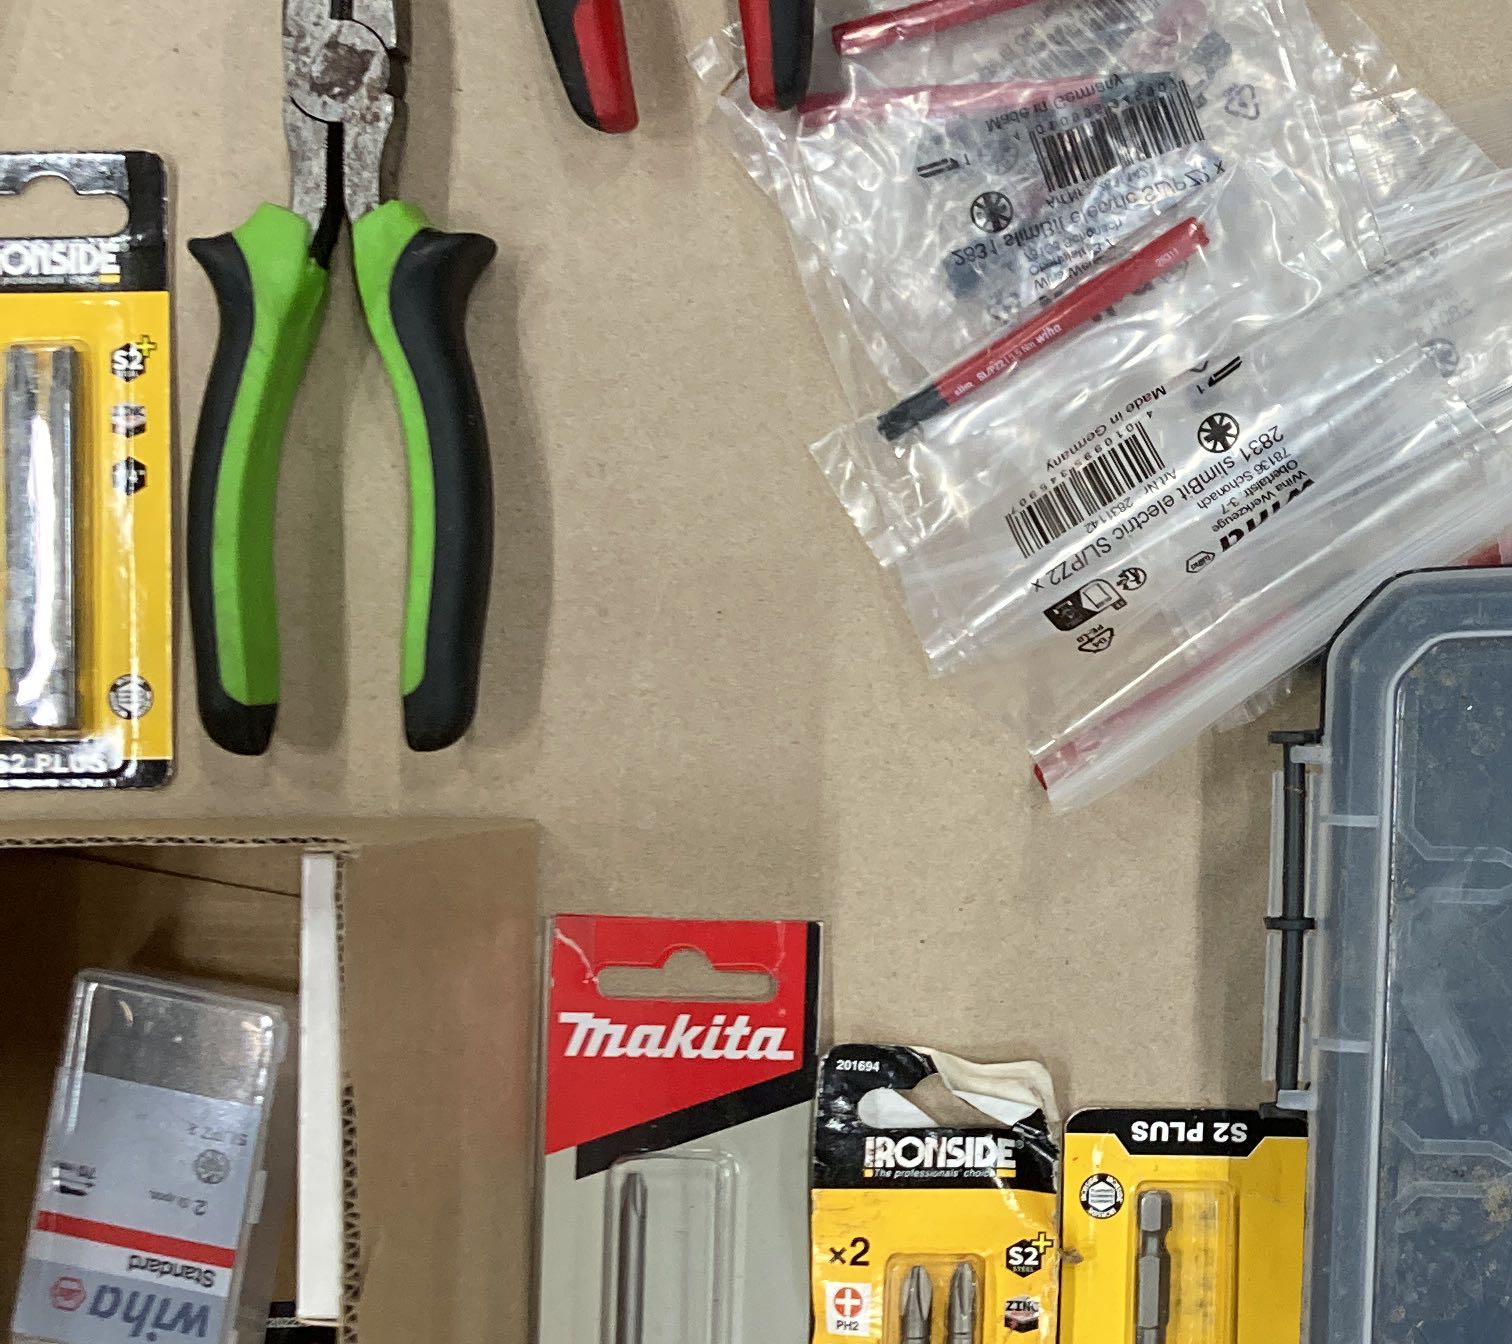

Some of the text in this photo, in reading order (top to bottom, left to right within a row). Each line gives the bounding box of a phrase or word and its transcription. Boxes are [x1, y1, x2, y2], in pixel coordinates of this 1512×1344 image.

[0, 241, 121, 275] ONSIDE
[1041, 382, 1167, 472] Made in Germany
[1195, 446, 1289, 511] 78136 Schonach
[1030, 424, 1285, 592] 2831 slimBit electric SL/PZ2 x
[1082, 496, 1134, 534] 2831142
[1209, 467, 1307, 534] Wiha Werkzeuge
[1218, 495, 1240, 514] 3-7
[558, 1012, 794, 1060] Makita
[836, 1059, 880, 1072] 201694
[1130, 1121, 1248, 1142] S2 PLUS
[865, 1136, 1017, 1169] IRONSIDE
[874, 1169, 892, 1177] The
[126, 1254, 215, 1288] Standard
[88, 1284, 209, 1343] wiha
[836, 1320, 859, 1330] PH2
